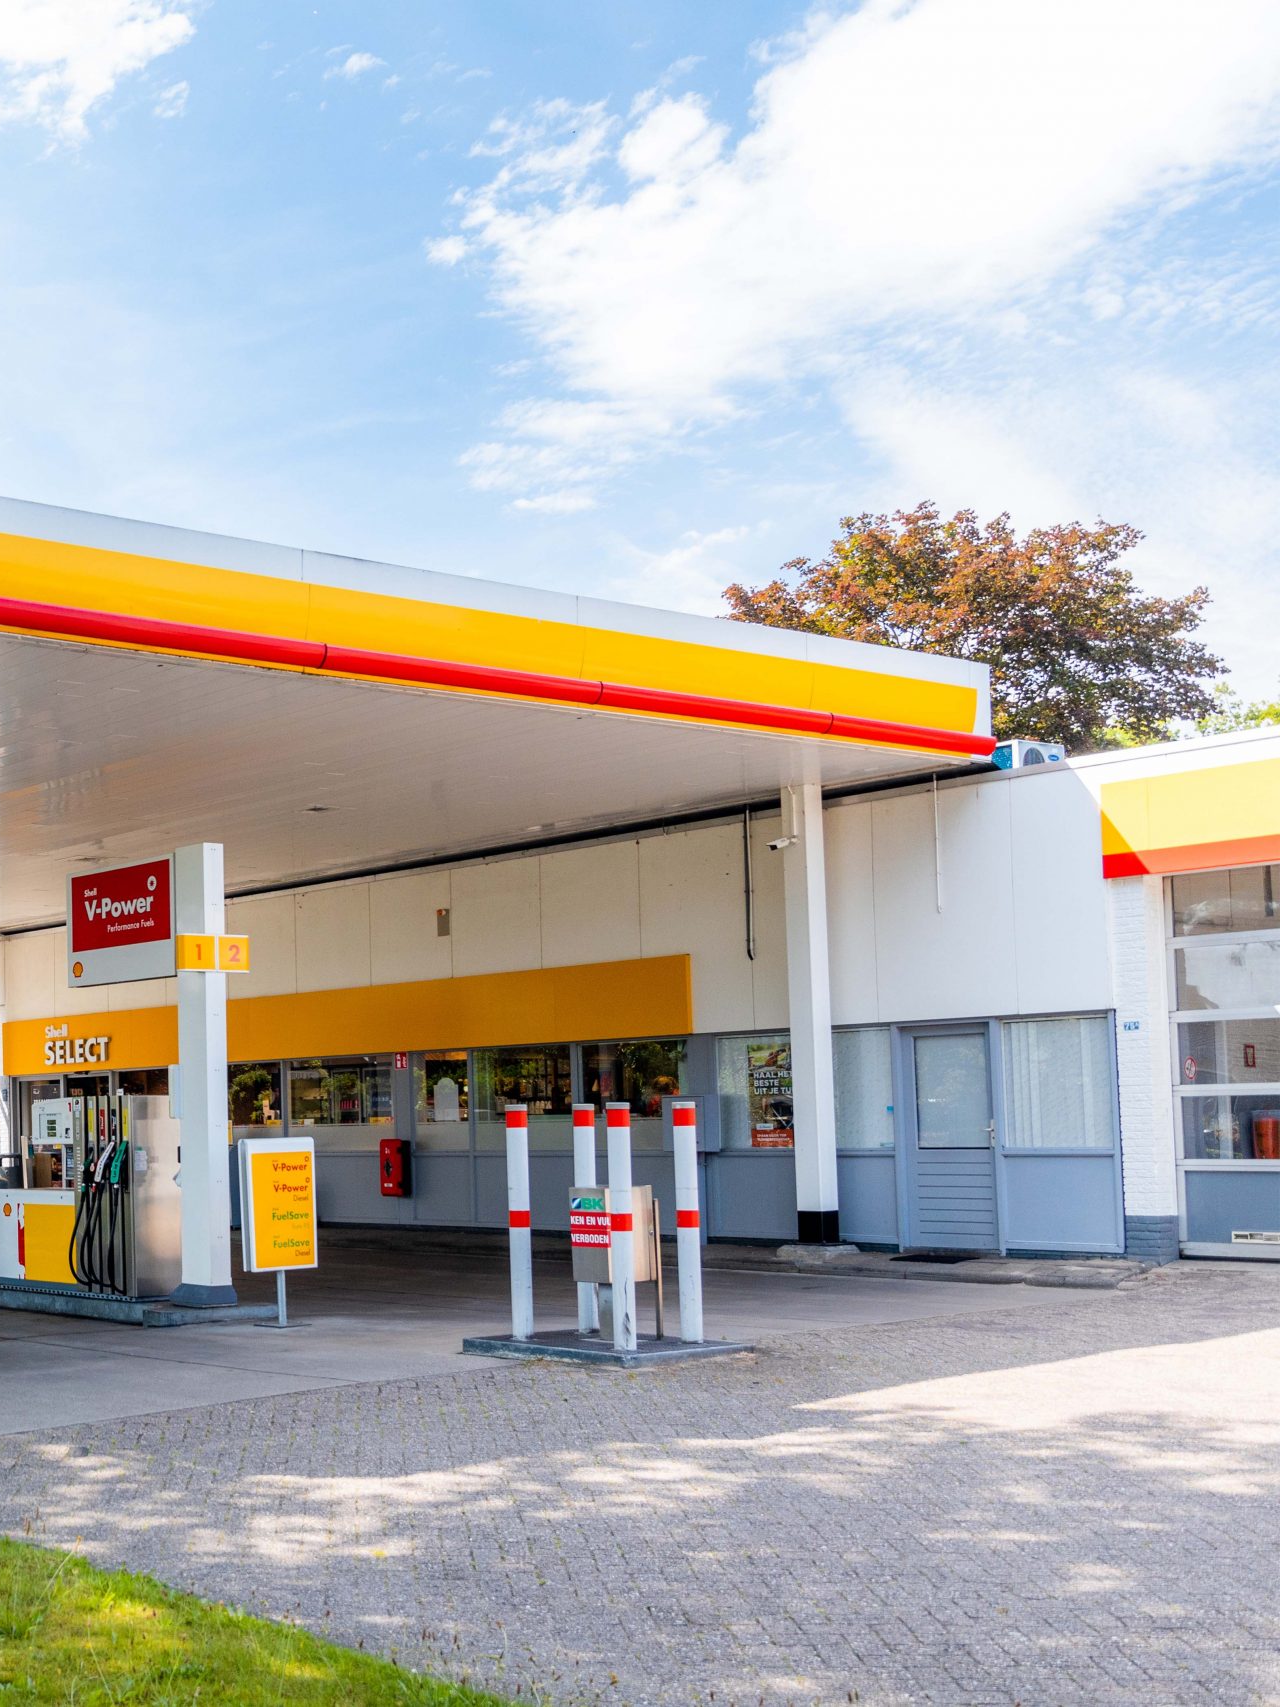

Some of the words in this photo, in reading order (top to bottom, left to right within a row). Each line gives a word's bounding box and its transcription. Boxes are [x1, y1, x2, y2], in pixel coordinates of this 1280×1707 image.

[84, 887, 98, 898] Shell
[84, 895, 154, 921] V-Power
[107, 922, 140, 933] Performance
[140, 918, 155, 927] Fuels
[195, 943, 202, 961] 1
[228, 944, 241, 963] 2
[44, 1023, 68, 1039] Shell
[44, 1037, 109, 1066] SELECT
[273, 1163, 307, 1172] V-Power
[274, 1184, 308, 1192] V-Power
[272, 1211, 309, 1220] FuelSave
[571, 1216, 584, 1224] KEN
[586, 1216, 596, 1225] EN
[571, 1234, 608, 1243] VERBODEN
[273, 1239, 310, 1248] FuelSave
[295, 1248, 310, 1256] Diesel
